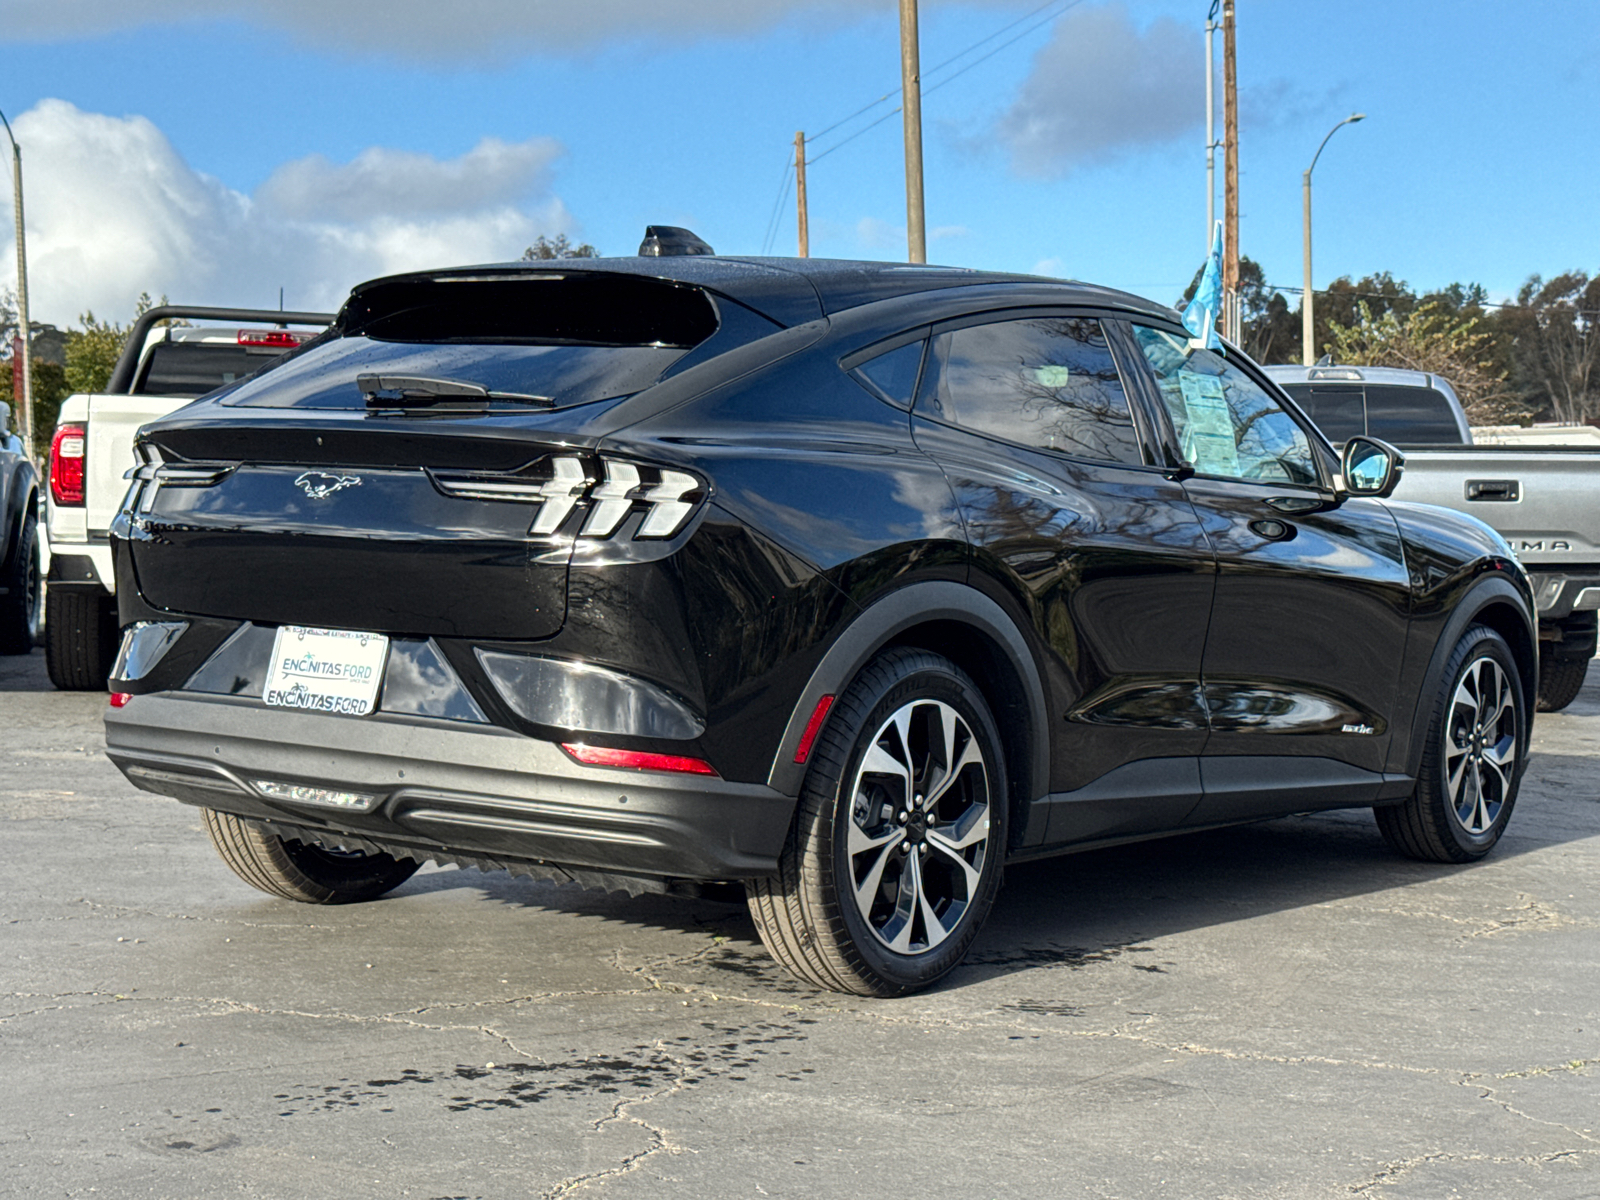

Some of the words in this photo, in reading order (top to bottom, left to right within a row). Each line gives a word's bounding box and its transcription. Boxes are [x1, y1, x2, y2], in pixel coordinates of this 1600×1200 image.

[282, 658, 342, 675] ENCINITAS
[343, 664, 372, 679] FORD
[267, 690, 334, 709] ENCINITAS
[334, 696, 368, 714] FORD
